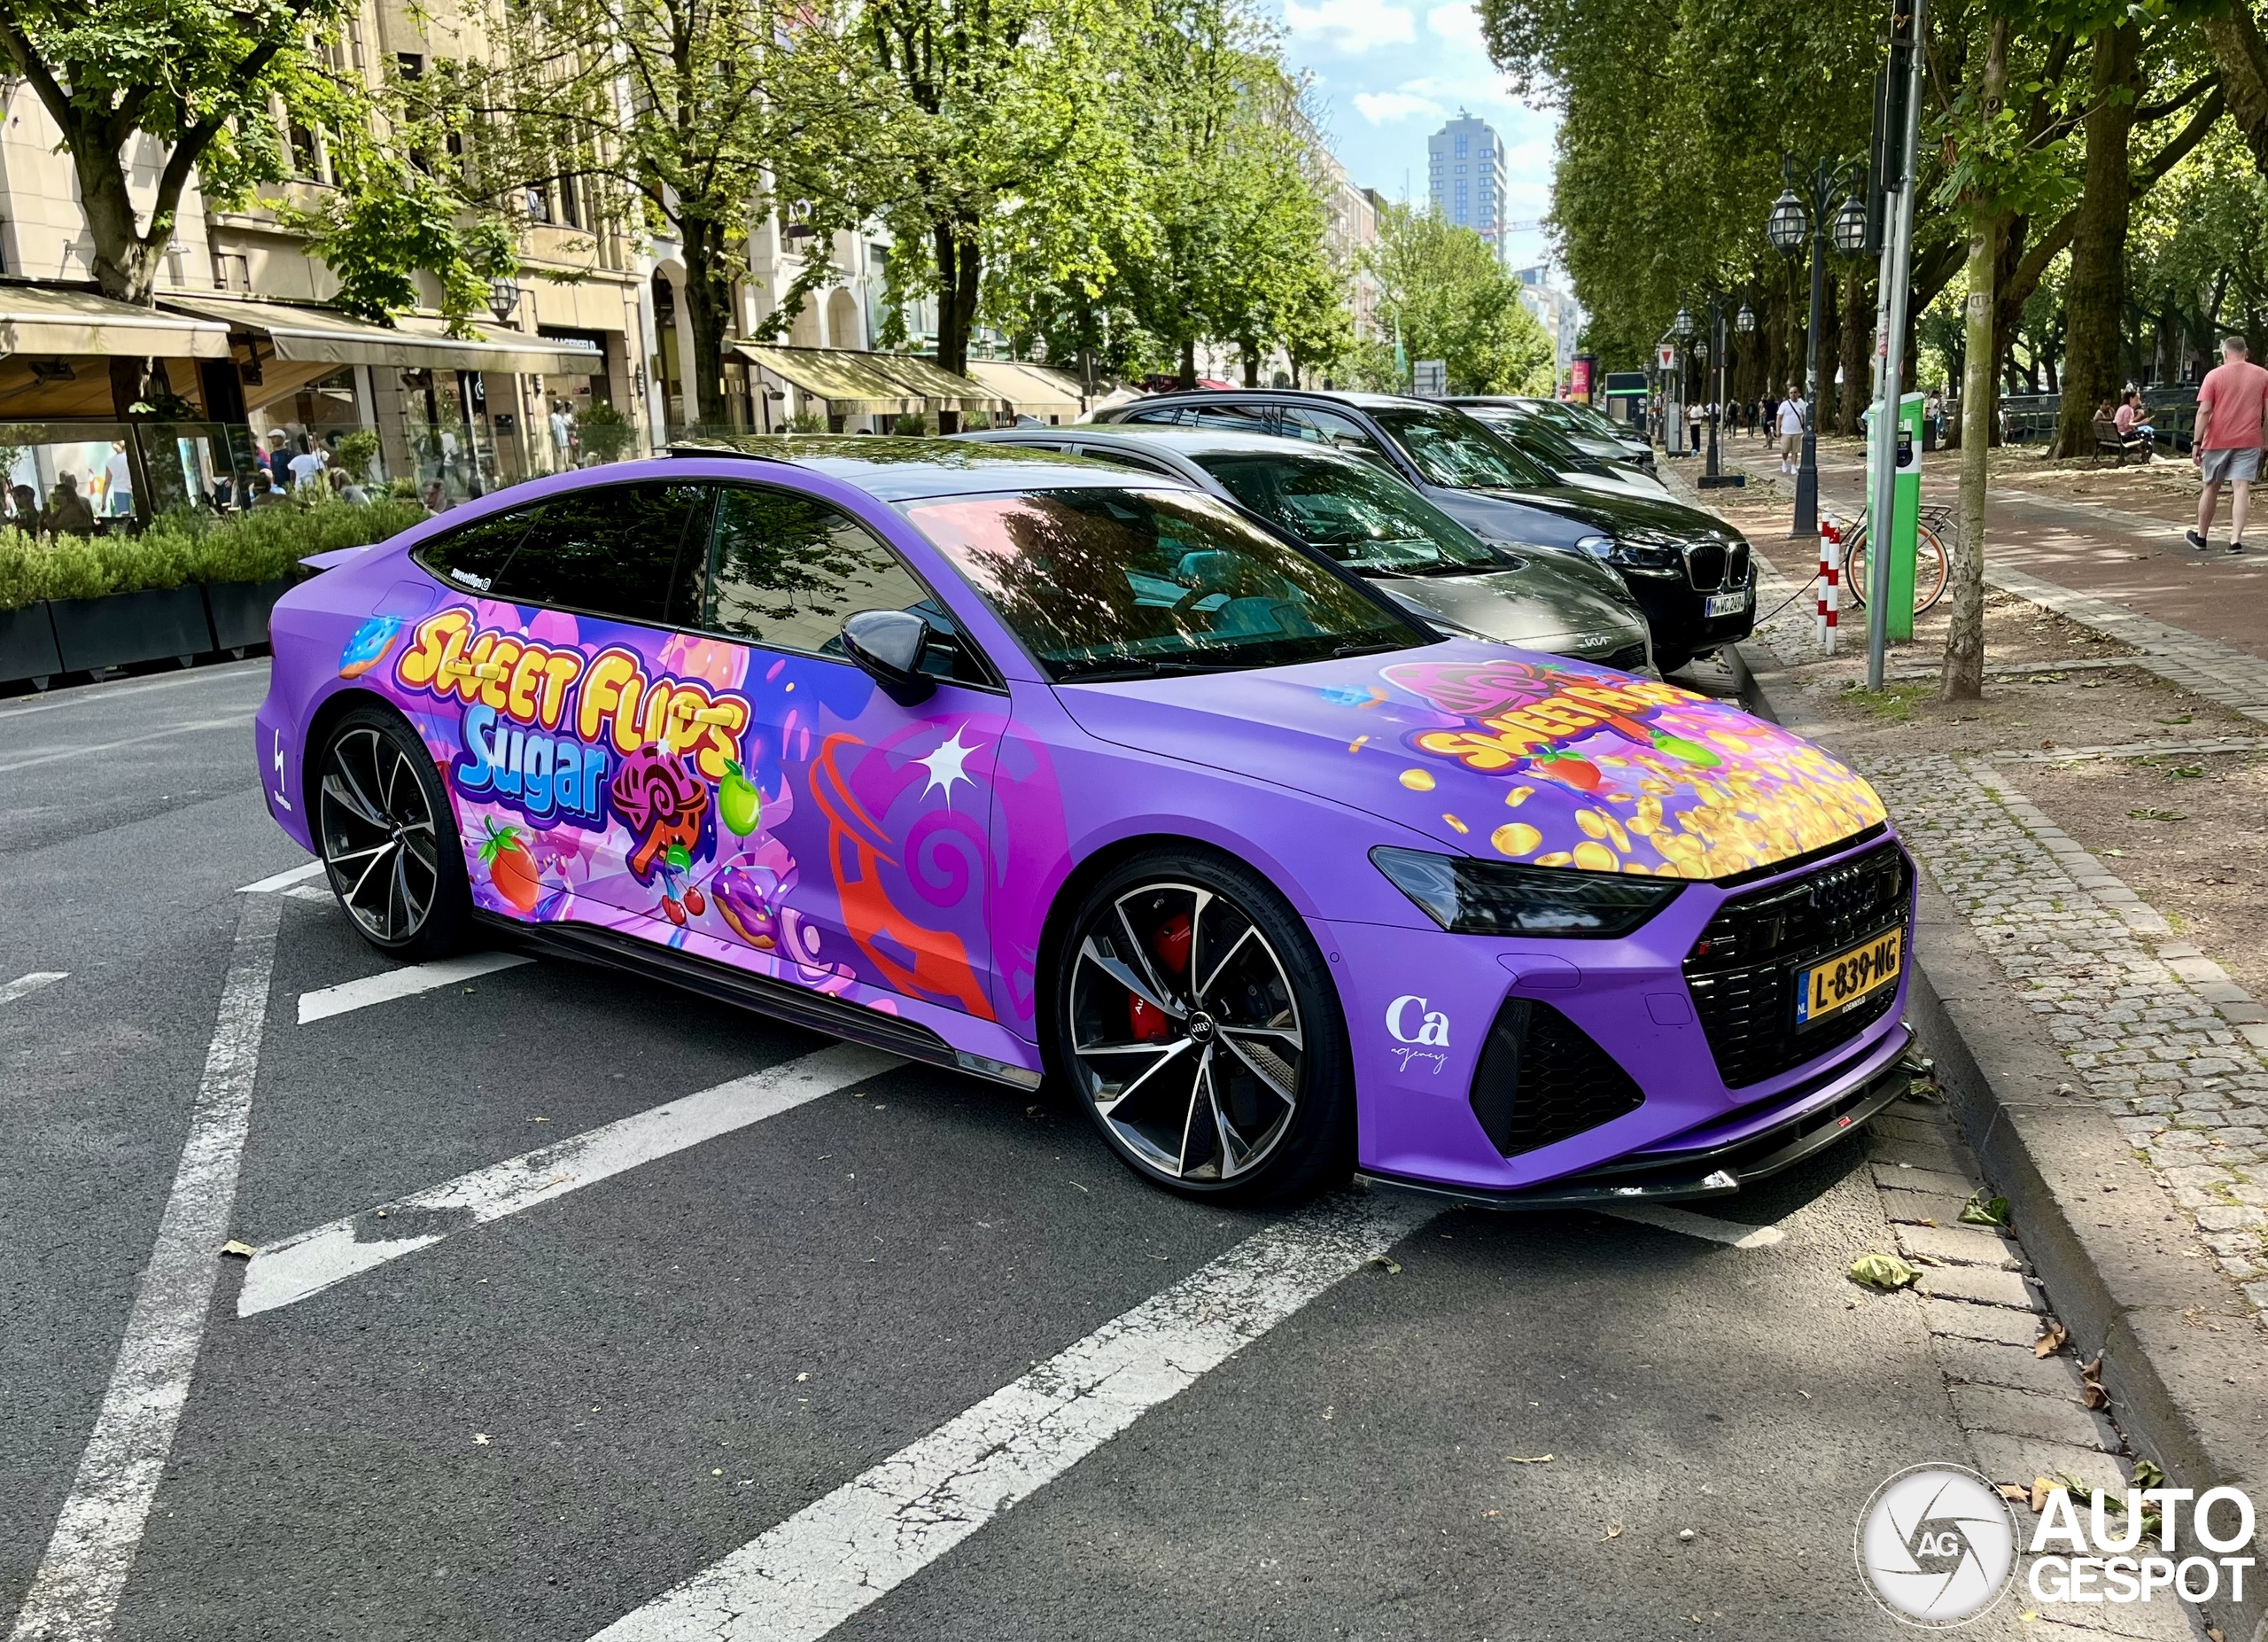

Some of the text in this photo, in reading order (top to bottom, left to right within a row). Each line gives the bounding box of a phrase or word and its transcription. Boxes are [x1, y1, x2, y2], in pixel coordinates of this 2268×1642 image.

[451, 568, 483, 588] sweetflips
[399, 611, 744, 778] SWEET FLIPS
[459, 704, 608, 820] Sugar
[1419, 696, 1613, 768] SWEET
[1815, 937, 1897, 1009] L-839-NG
[1385, 995, 1449, 1047] Ca
[1798, 1002, 1807, 1016] NL
[1391, 1047, 1448, 1075] agency
